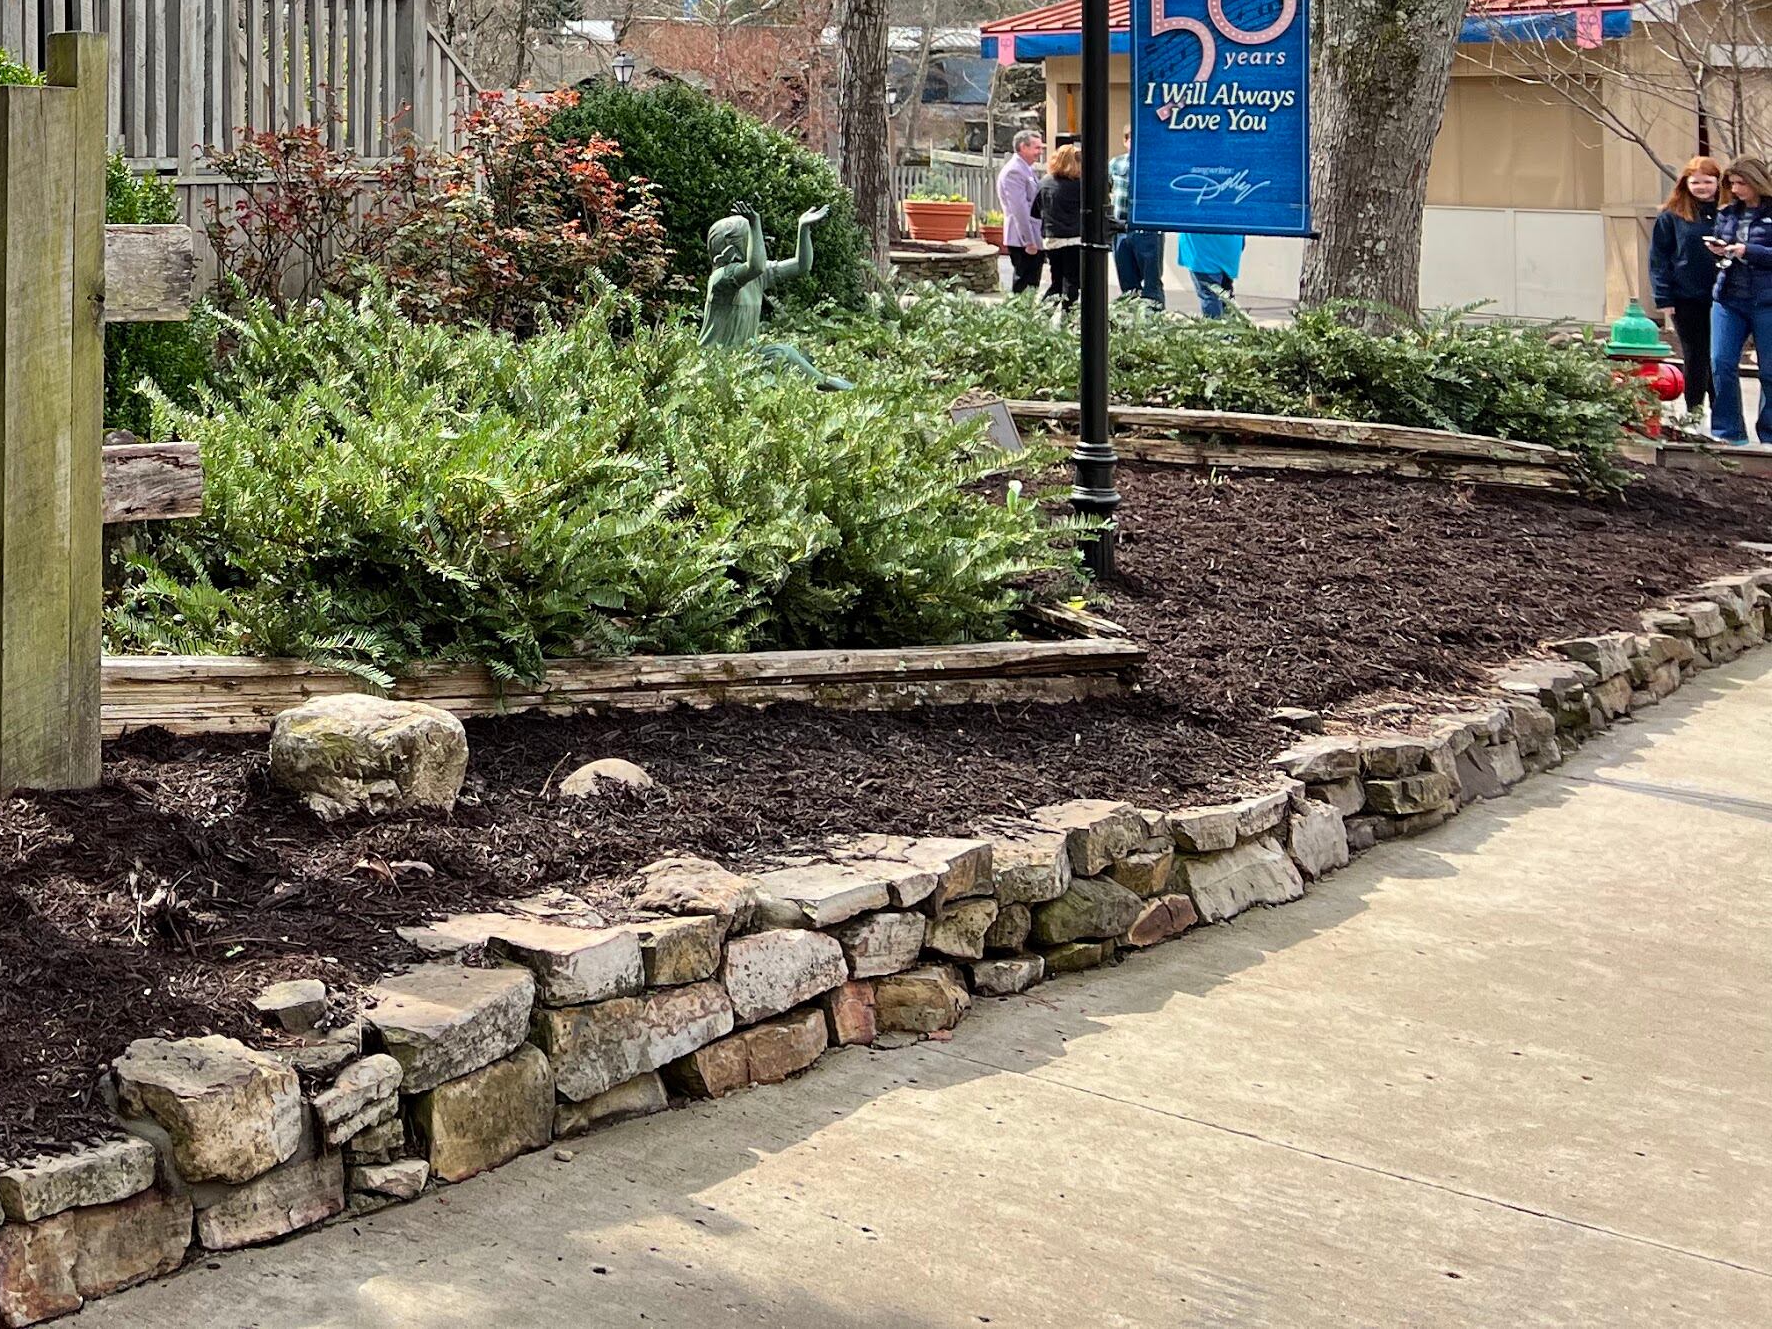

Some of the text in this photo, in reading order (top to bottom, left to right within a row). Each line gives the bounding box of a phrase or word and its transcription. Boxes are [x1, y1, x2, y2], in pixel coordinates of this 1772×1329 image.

[1223, 49, 1287, 70] years
[1144, 82, 1296, 116] I Will Always
[1168, 108, 1268, 132] Love You
[1170, 169, 1272, 206] Dolly
